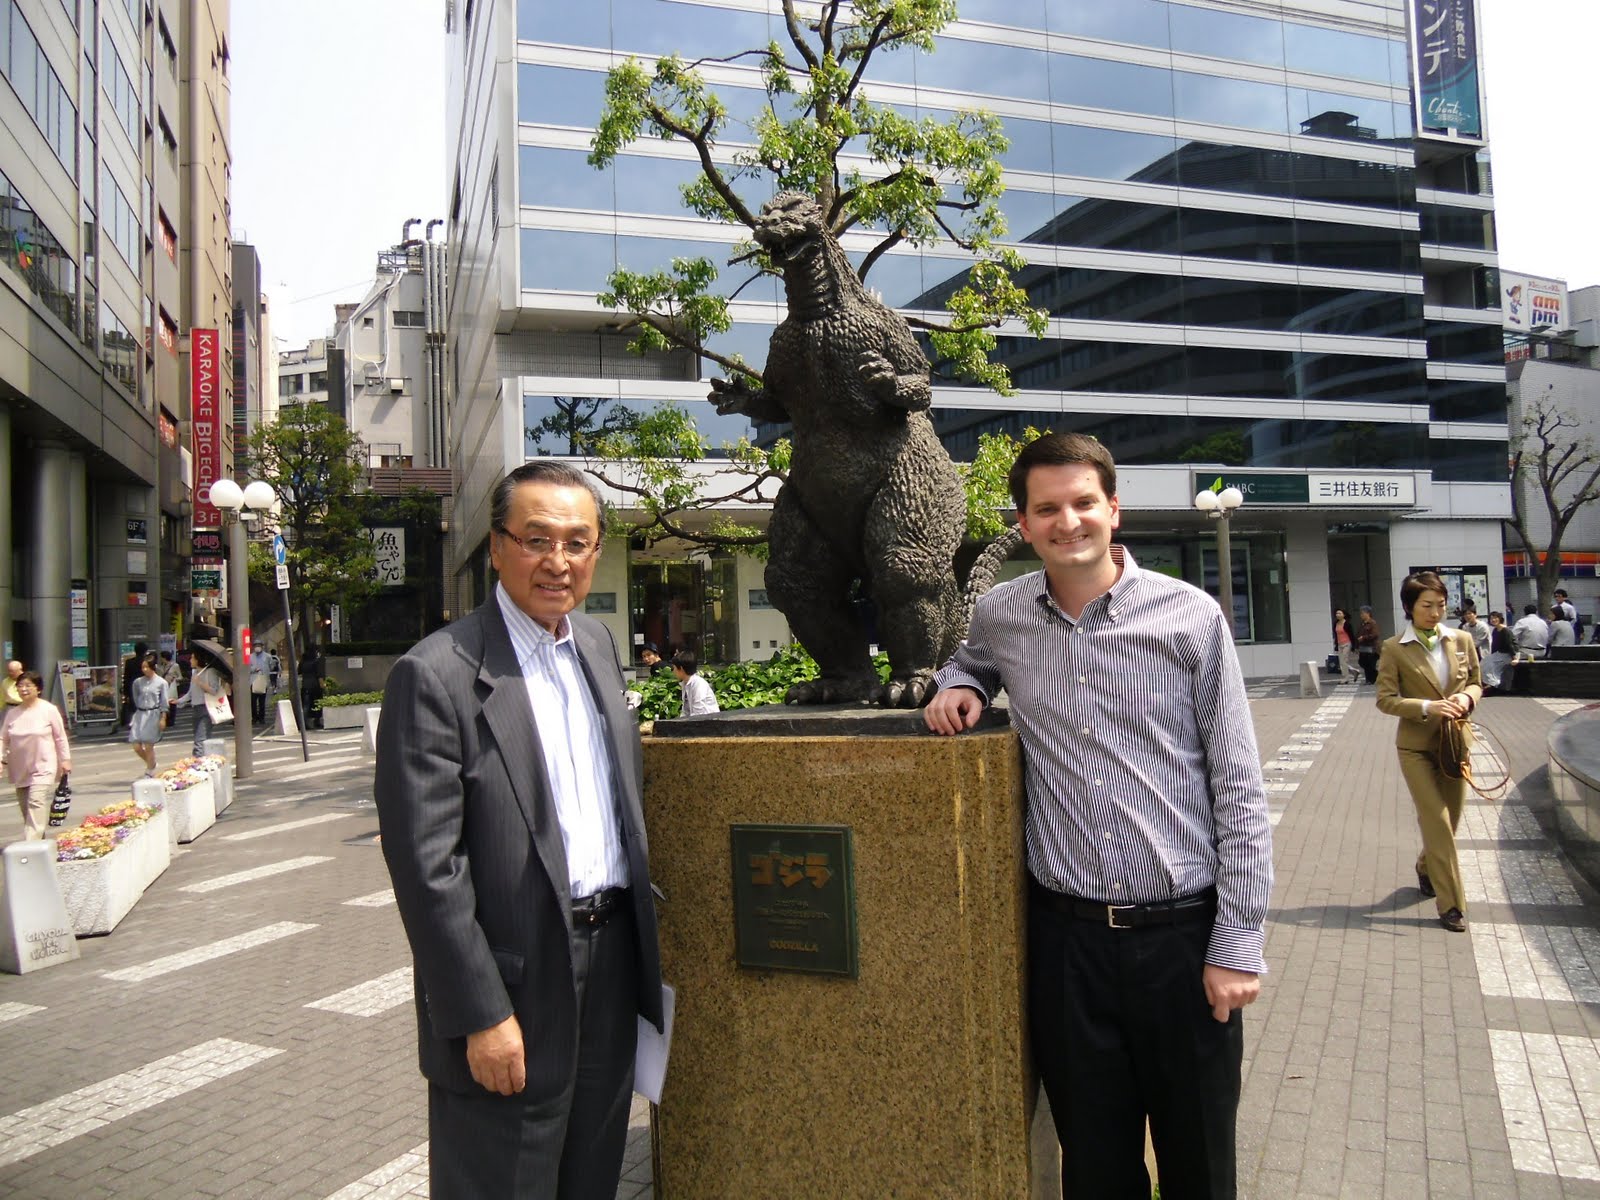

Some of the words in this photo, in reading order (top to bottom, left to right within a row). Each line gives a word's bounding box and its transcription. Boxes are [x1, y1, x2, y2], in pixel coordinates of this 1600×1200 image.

[1531, 309, 1559, 325] pm
[1532, 295, 1560, 311] am
[199, 334, 213, 416] KARAOKE
[195, 422, 212, 454] BIG
[196, 457, 212, 504] ECHO
[1319, 481, 1400, 497] 三井住友銀行
[751, 851, 833, 888] ゴジラ
